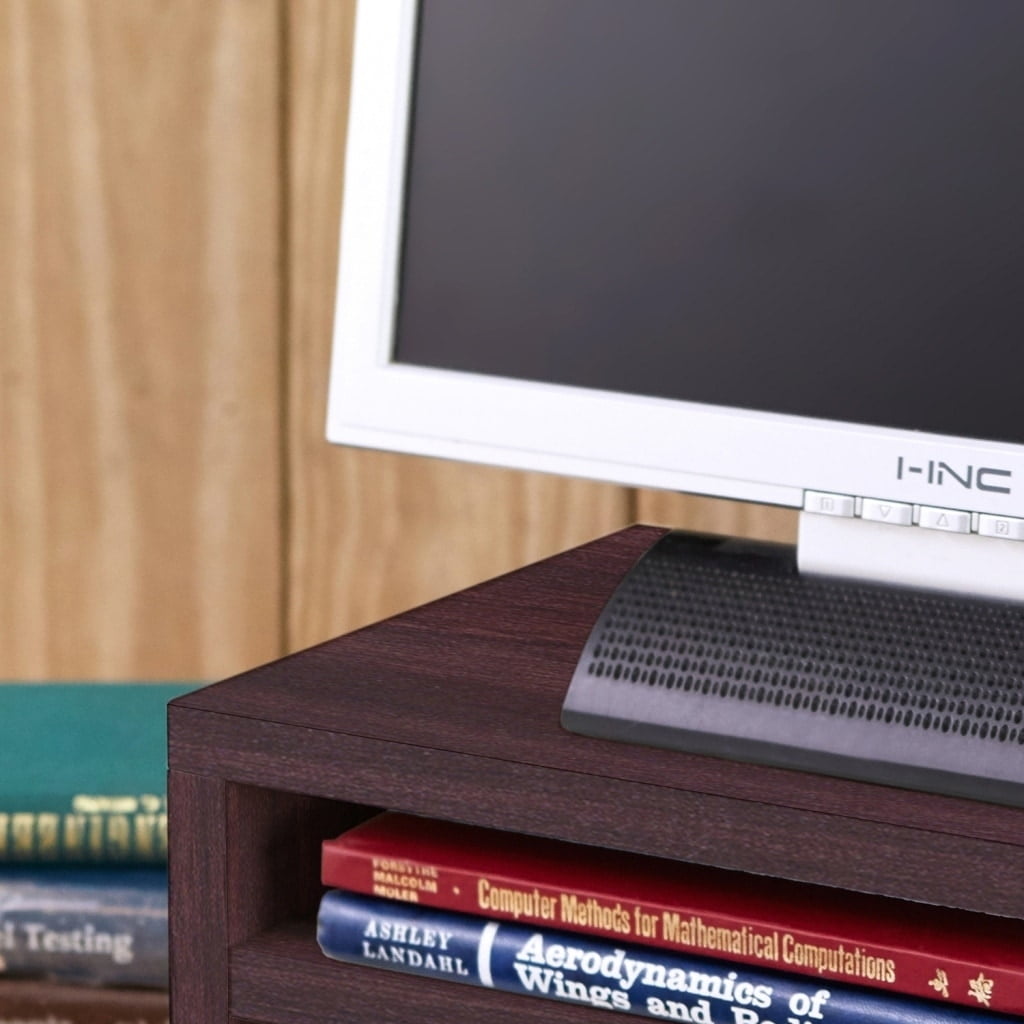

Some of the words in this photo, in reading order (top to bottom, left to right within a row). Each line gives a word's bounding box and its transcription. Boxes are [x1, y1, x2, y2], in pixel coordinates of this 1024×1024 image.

[373, 870, 438, 894] MALCOLM
[373, 884, 419, 902] MOLER
[23, 922, 134, 964] Testing
[364, 919, 453, 950] ASHLEY
[478, 879, 556, 920] Computer
[561, 895, 630, 935] Methods
[635, 907, 659, 938] for
[663, 912, 778, 960] Mathematical
[782, 935, 896, 984] Computations
[362, 941, 469, 976] LANDAHL
[515, 934, 773, 1008] Aerodynamics
[789, 989, 830, 1020] of
[514, 963, 632, 1010] Wings
